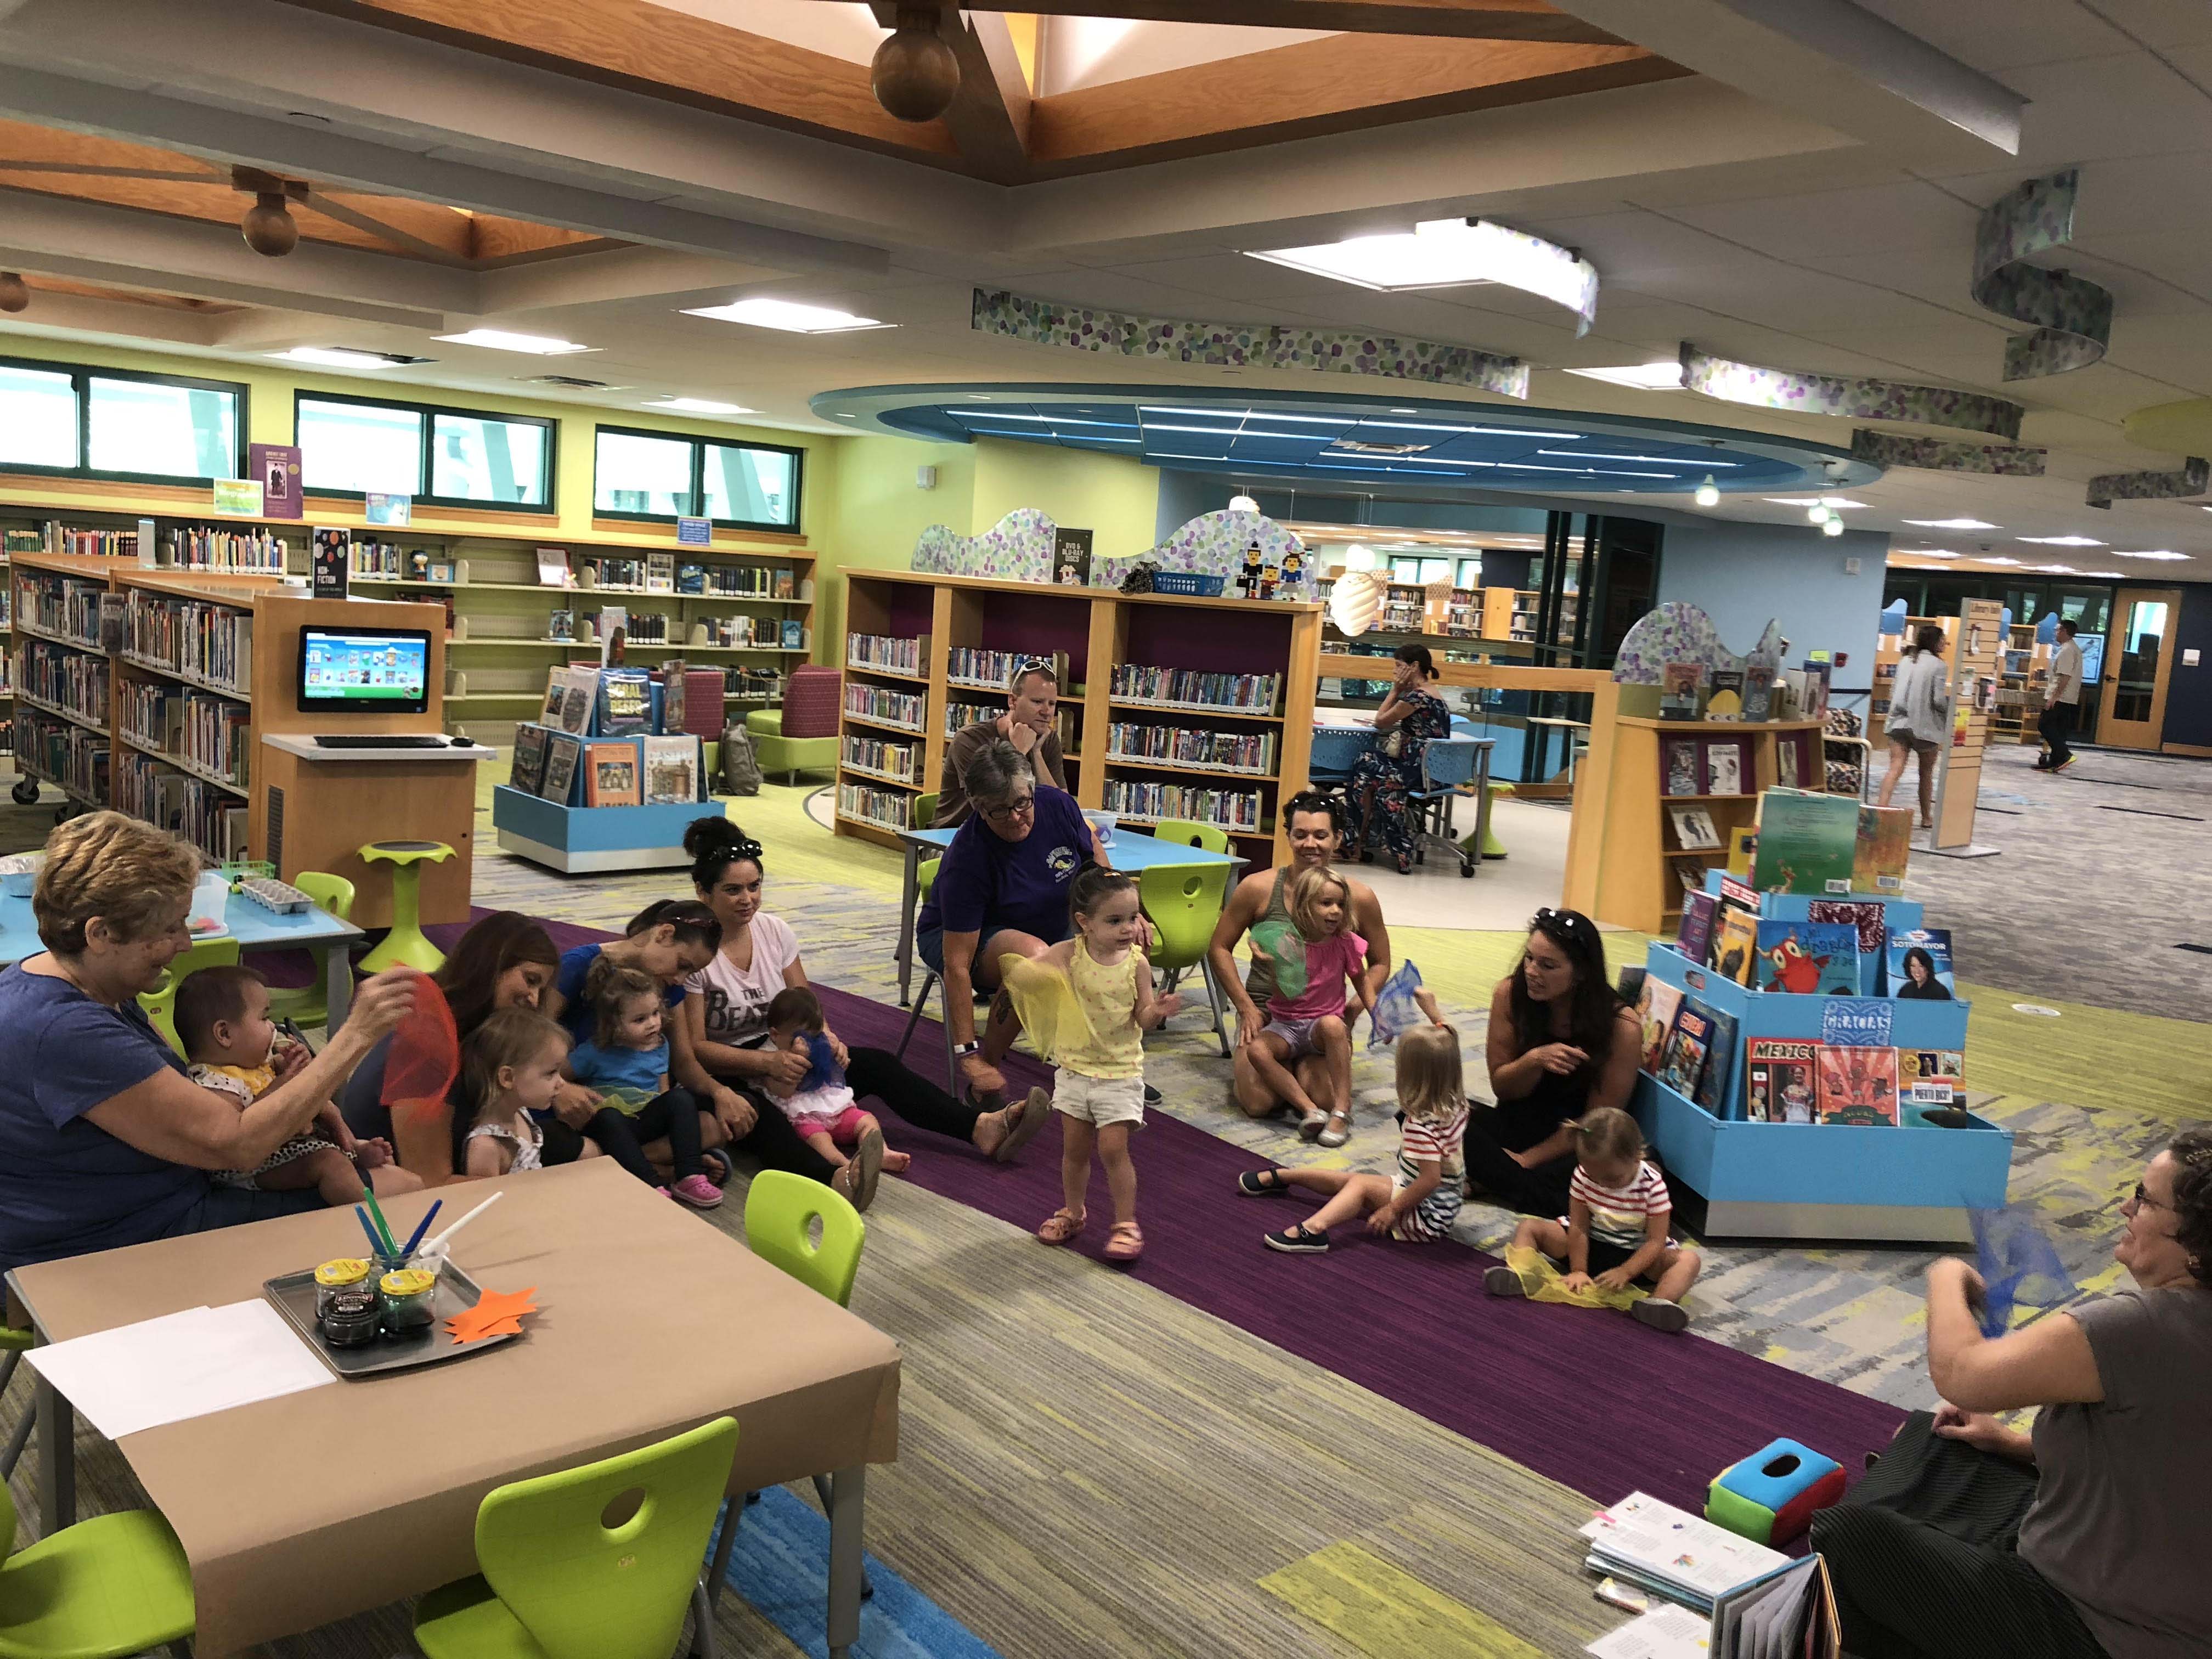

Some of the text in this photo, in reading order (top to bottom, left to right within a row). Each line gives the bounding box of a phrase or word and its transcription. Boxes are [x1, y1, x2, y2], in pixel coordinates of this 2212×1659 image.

[1062, 548, 1084, 556] BLU-RAY
[317, 566, 330, 575] NON-
[317, 575, 336, 584] FICTION
[1891, 940, 1946, 950] SOTOMAYOR
[704, 989, 770, 1033] BEAT
